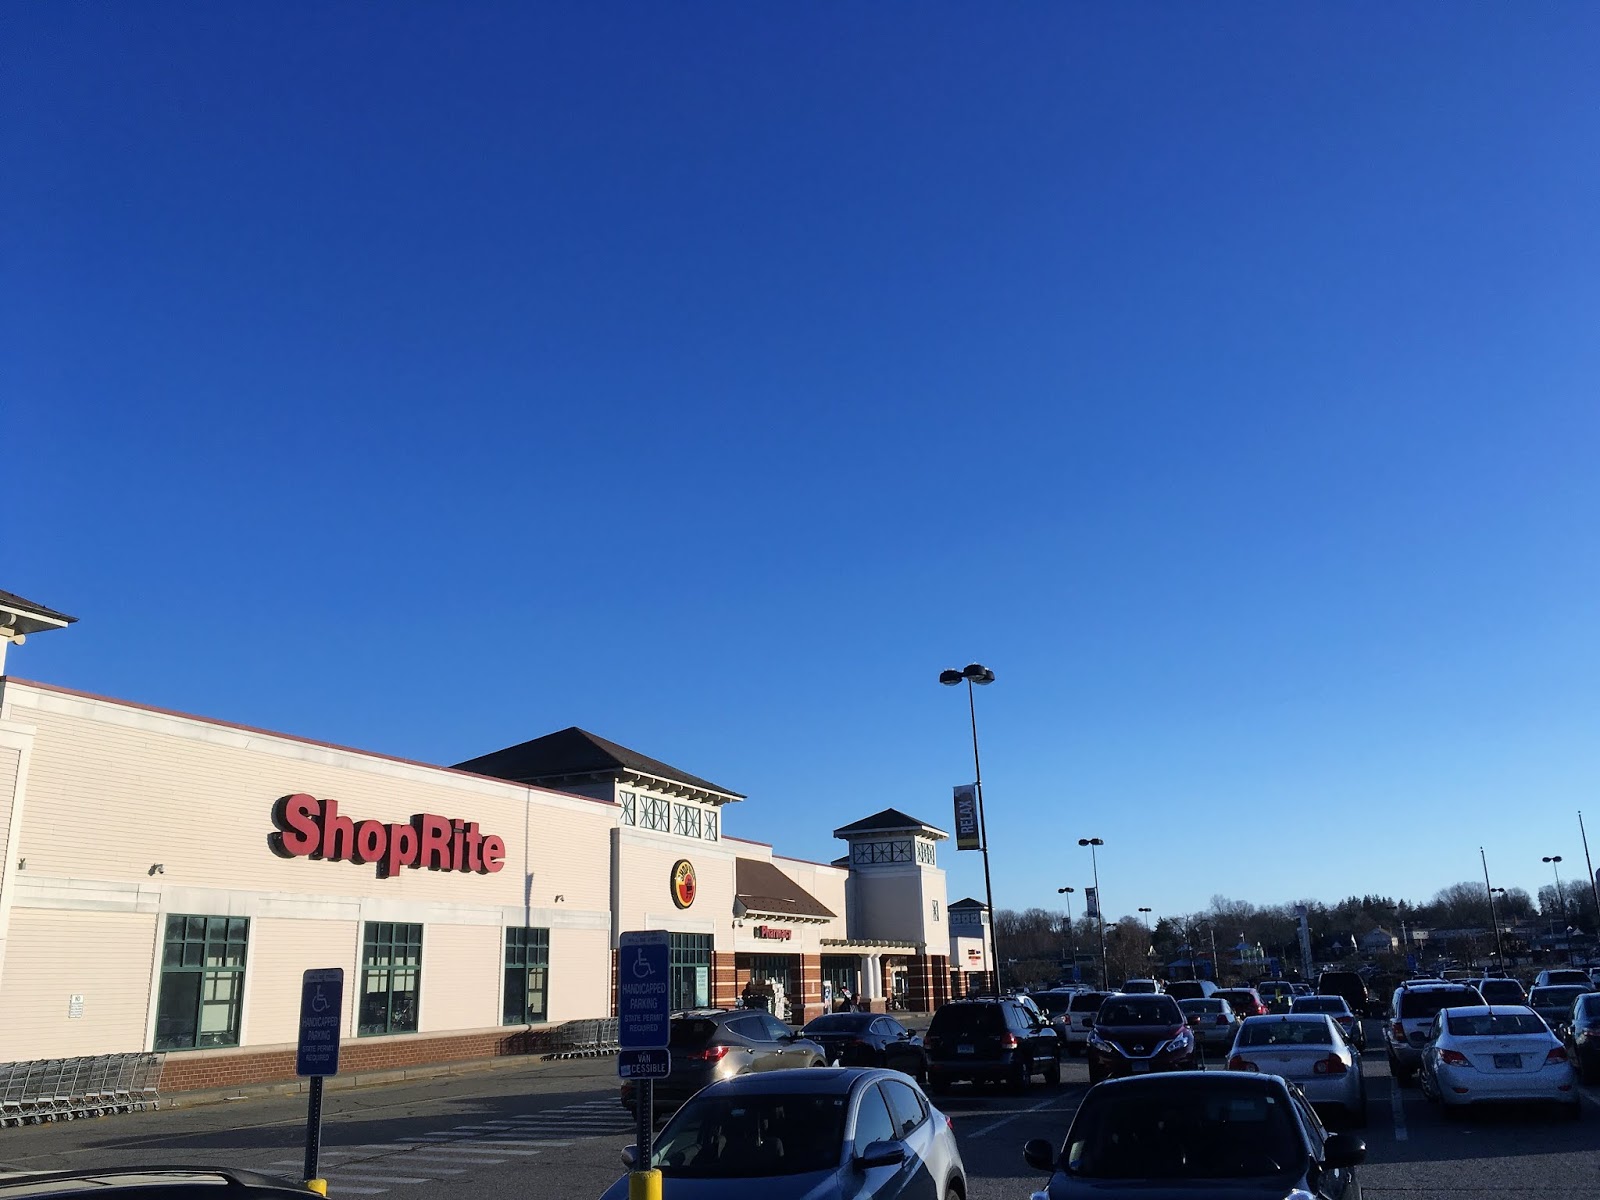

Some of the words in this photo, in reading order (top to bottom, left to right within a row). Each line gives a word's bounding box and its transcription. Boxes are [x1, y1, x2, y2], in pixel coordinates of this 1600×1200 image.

[959, 800, 974, 834] RELAX
[282, 793, 505, 877] ShopRite
[761, 925, 792, 940] Pharmacy
[622, 982, 666, 995] HANDICAPPED
[630, 997, 658, 1010] PARKING
[302, 1016, 338, 1028] HANDICAPPED
[624, 1014, 641, 1023] STATE
[642, 1013, 664, 1022] PERMIT
[629, 1023, 659, 1032] REQUIRED
[307, 1030, 331, 1041] PARKING
[305, 1053, 330, 1062] REQUIRED
[637, 1054, 651, 1064] VAN
[623, 1063, 666, 1074] CESSIBLE
